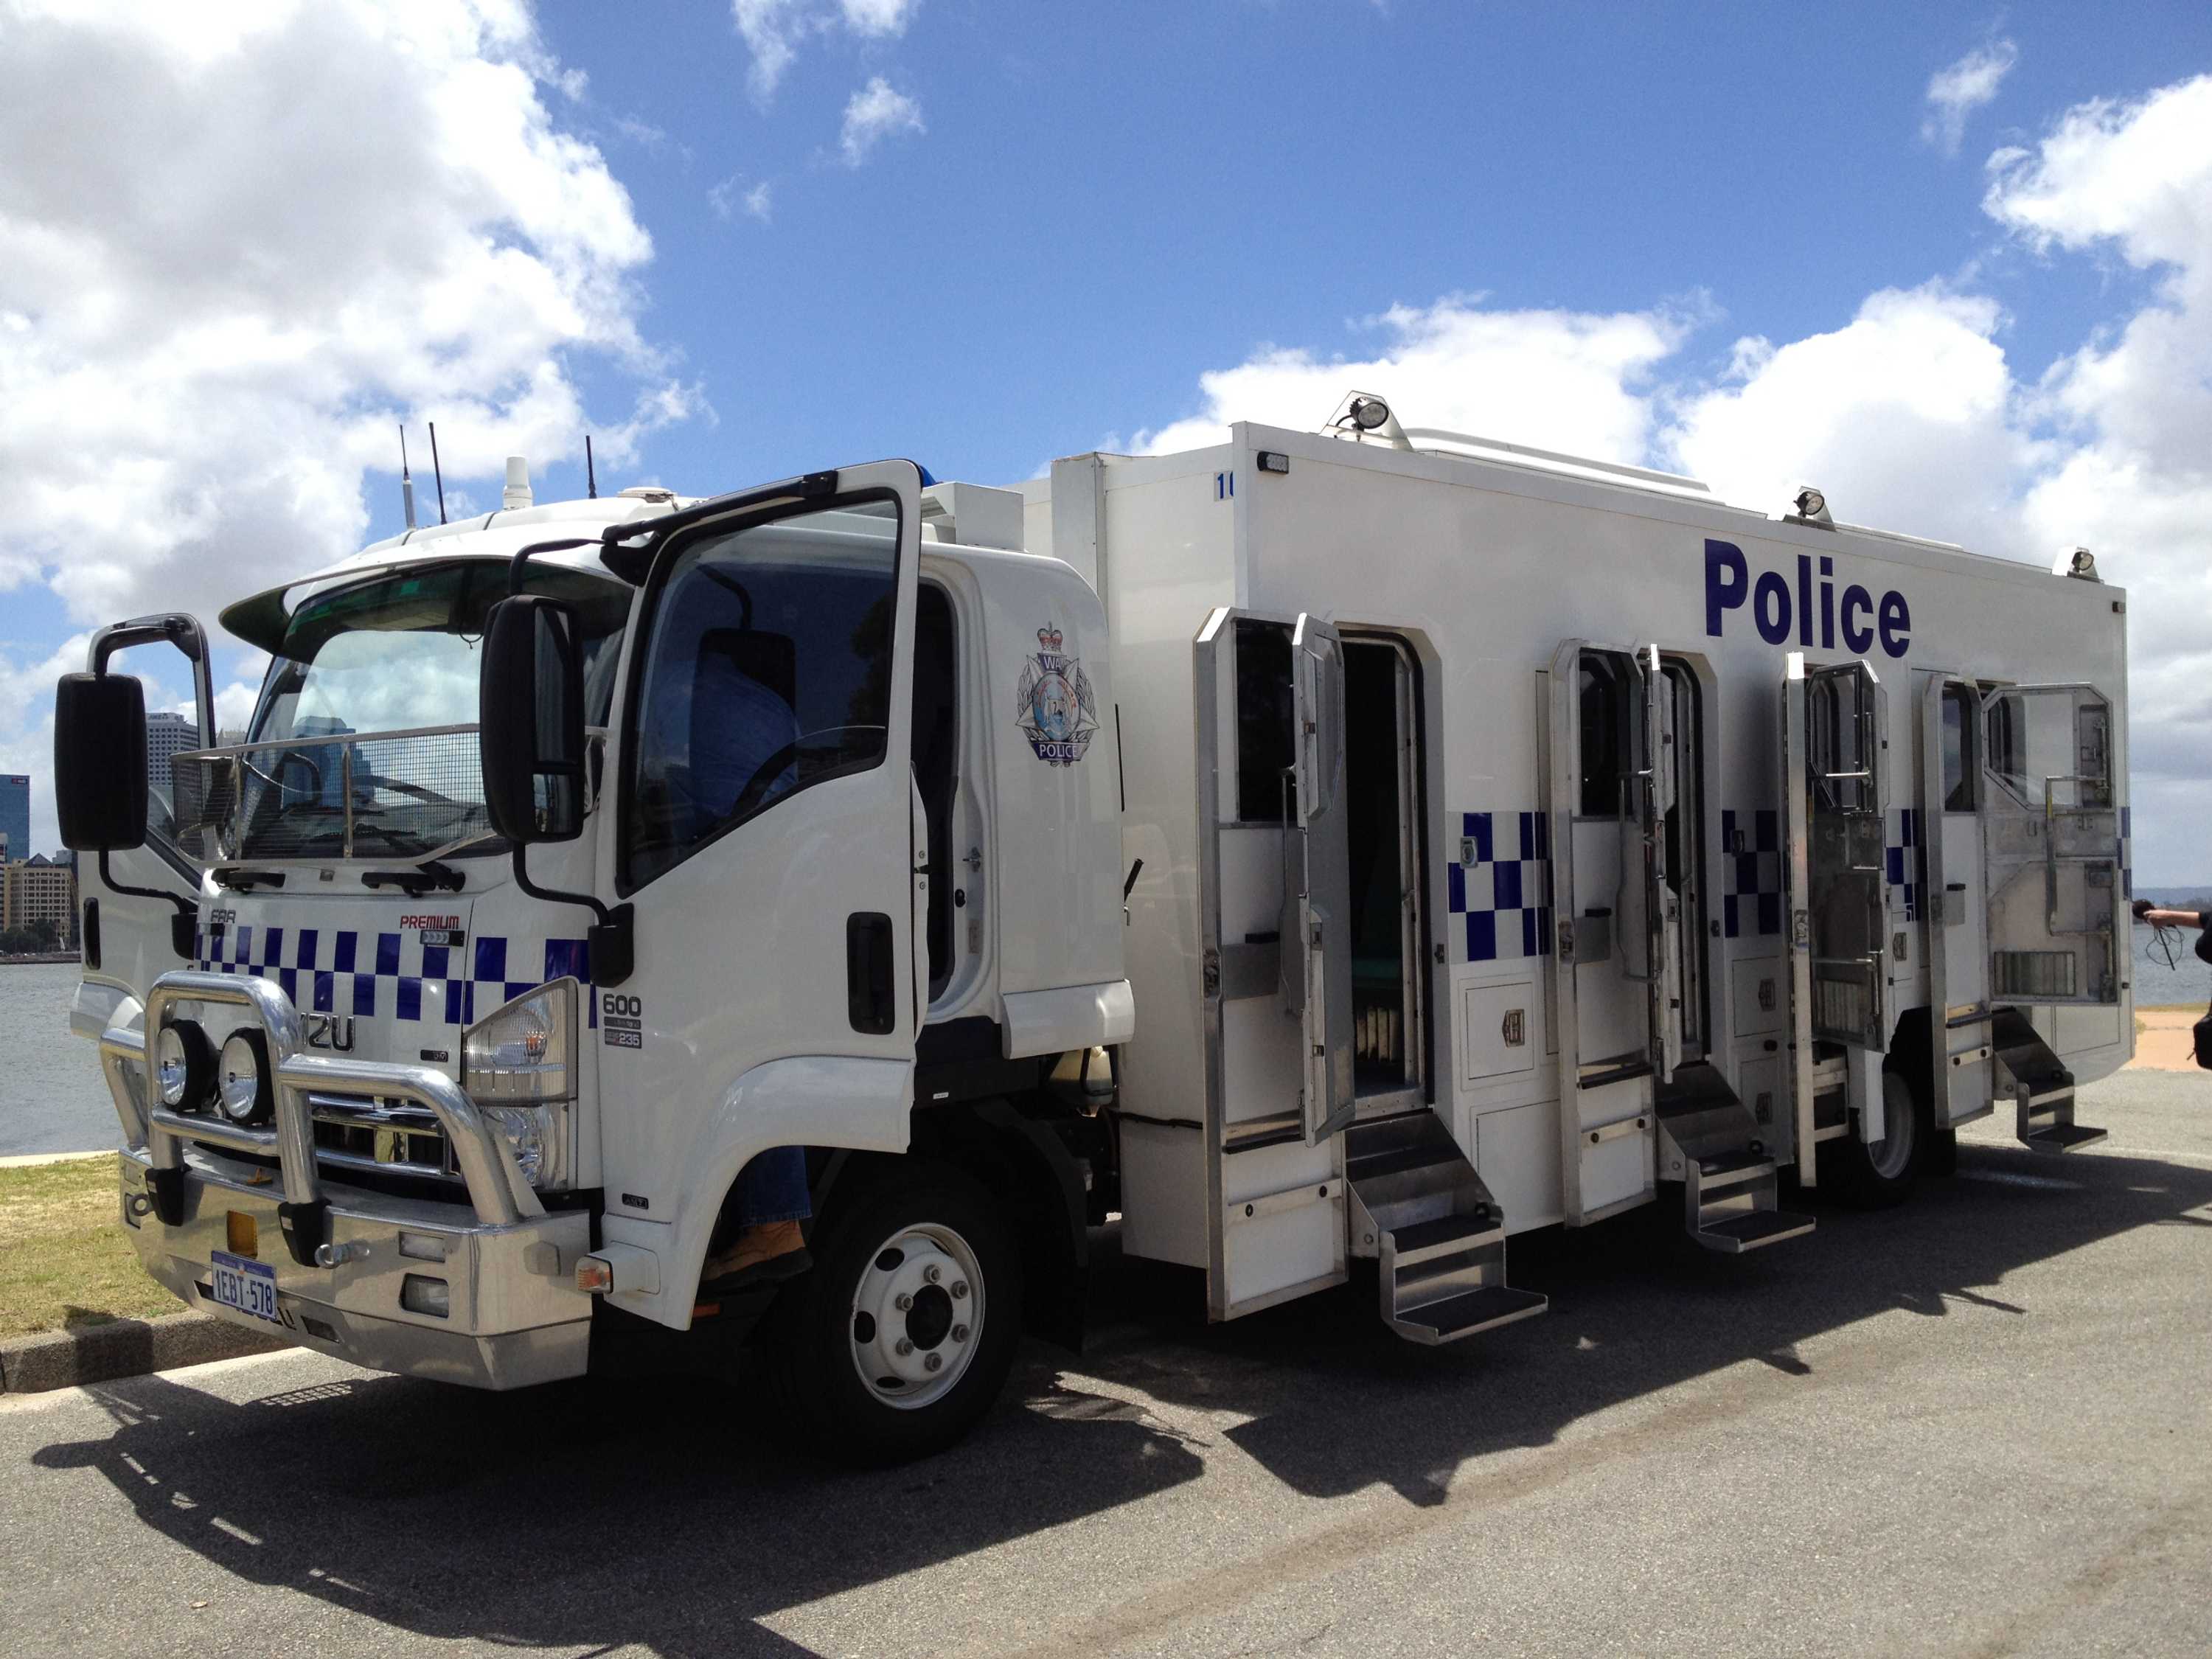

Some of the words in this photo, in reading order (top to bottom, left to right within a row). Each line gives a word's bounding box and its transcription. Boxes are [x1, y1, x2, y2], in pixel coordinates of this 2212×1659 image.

[1704, 538, 1911, 658] Police
[1043, 655, 1062, 670] WA
[1039, 743, 1079, 759] POLICE
[400, 915, 459, 930] PREMIUM
[603, 993, 641, 1018] 600
[619, 1032, 640, 1046] 235
